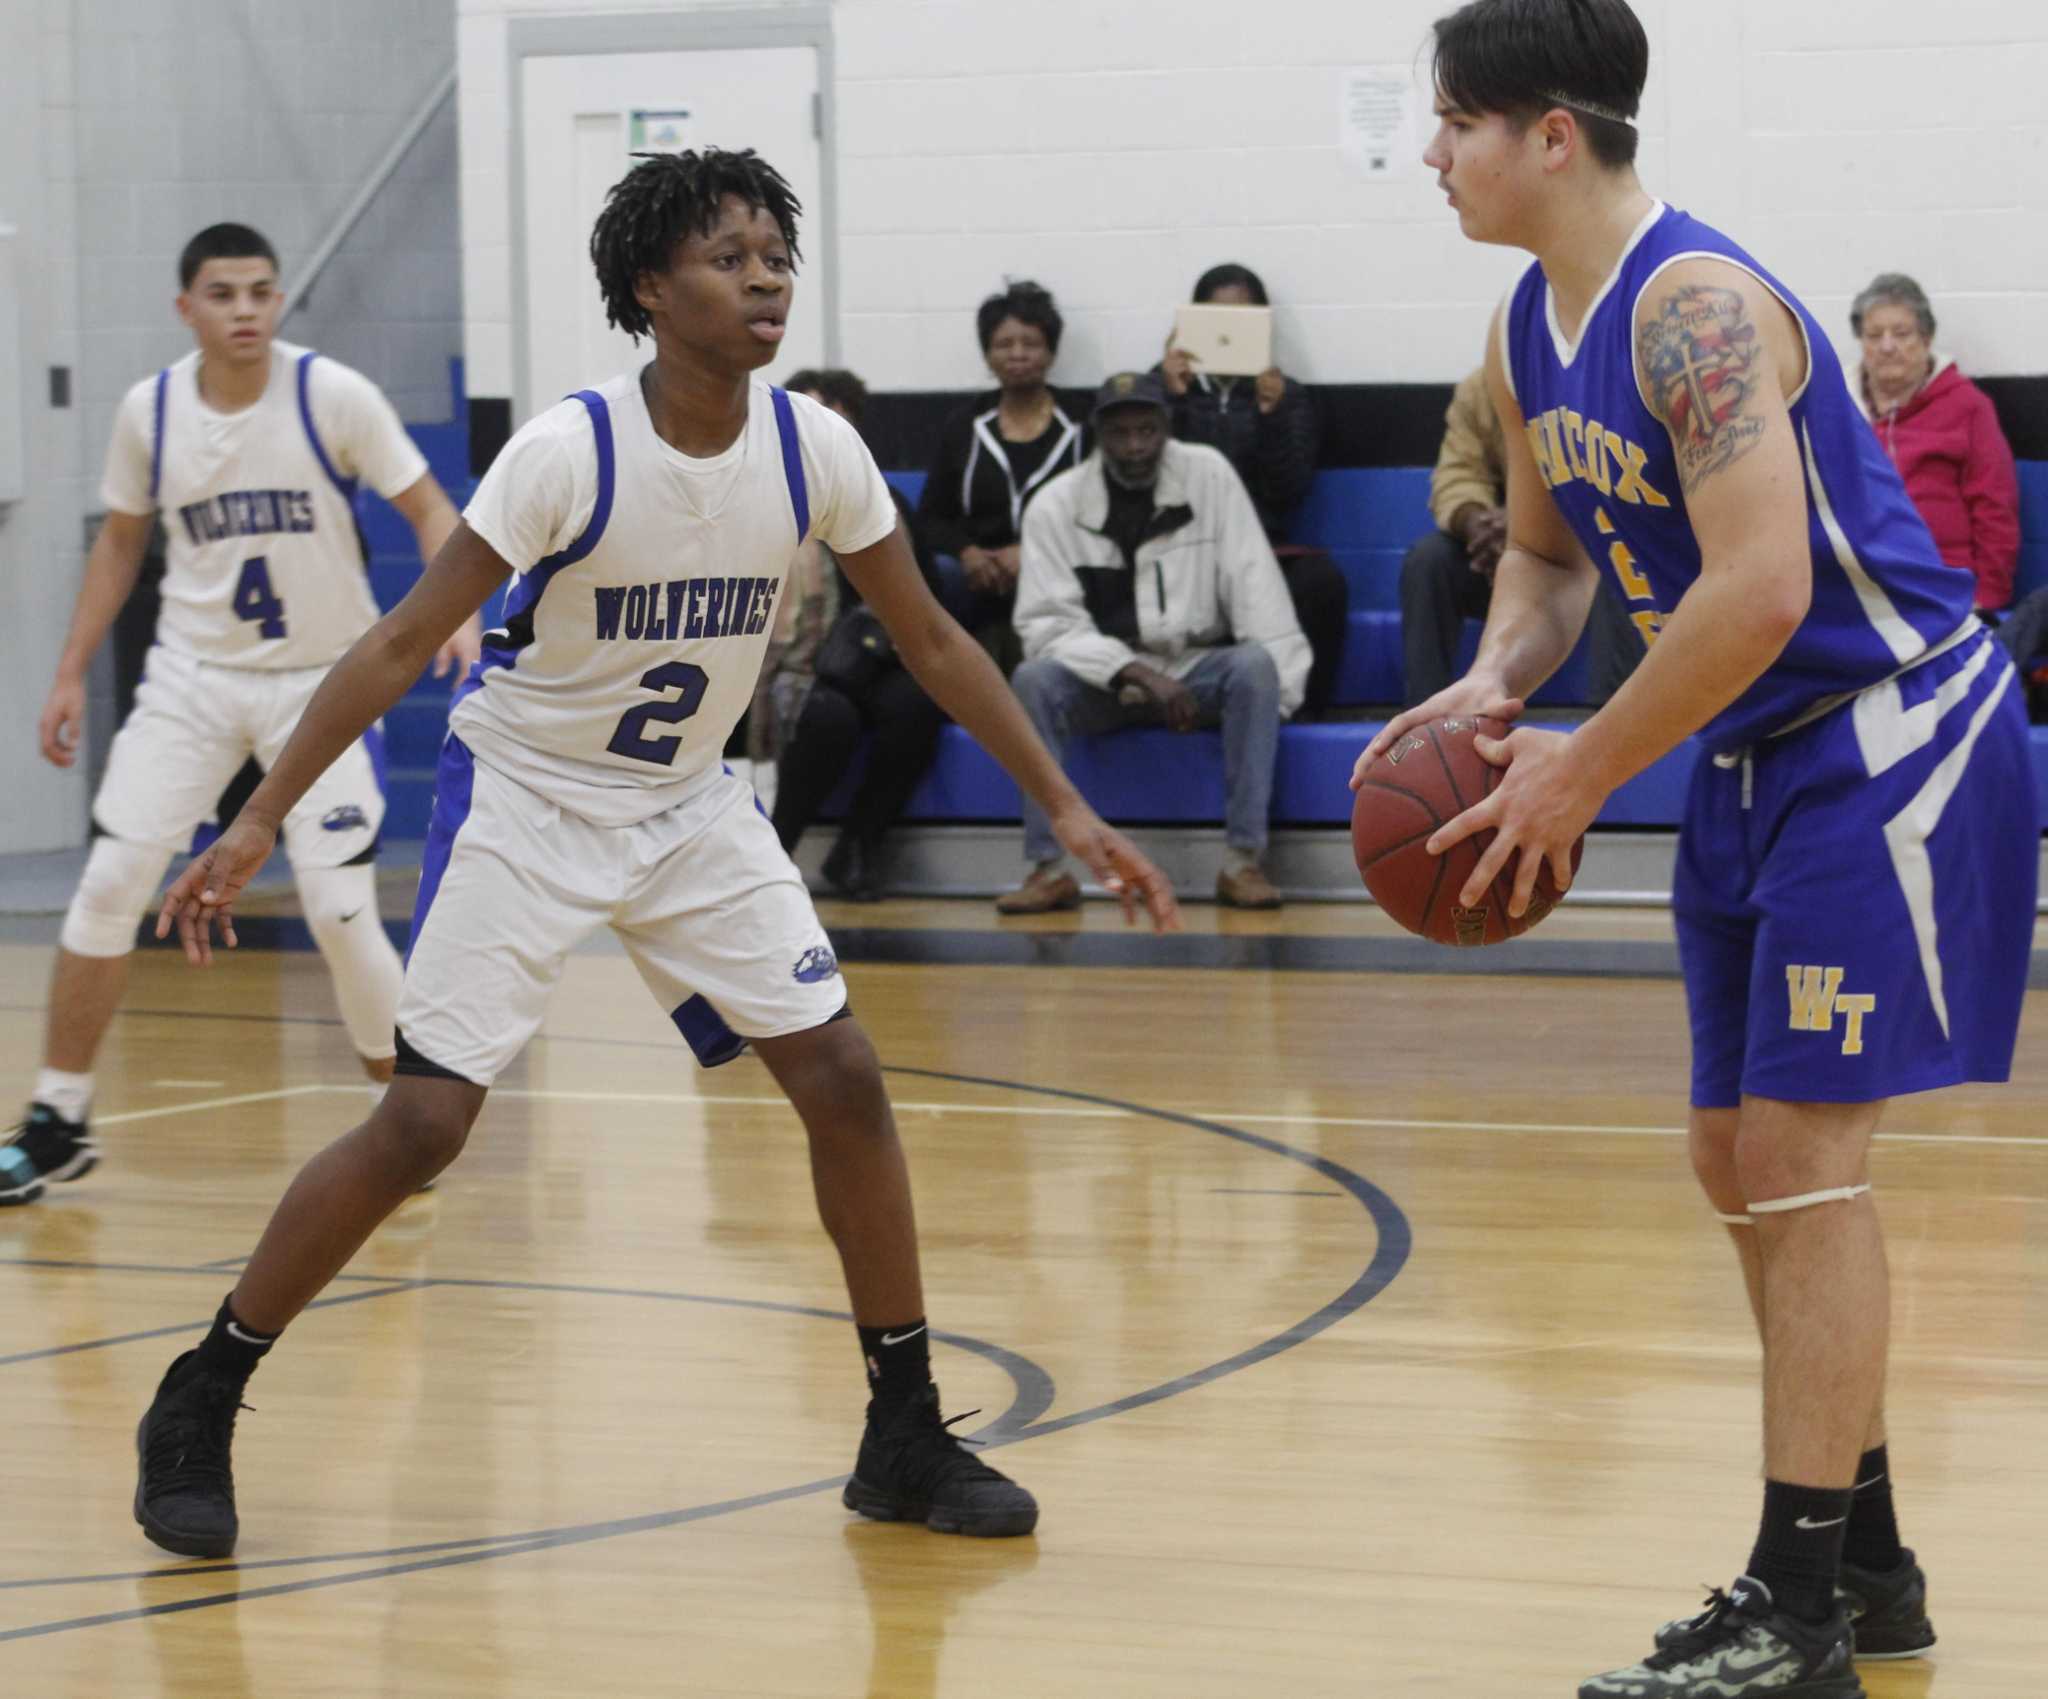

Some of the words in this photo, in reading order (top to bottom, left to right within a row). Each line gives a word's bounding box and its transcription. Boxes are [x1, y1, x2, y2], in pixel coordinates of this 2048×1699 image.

[232, 556, 287, 639] 4
[594, 577, 780, 641] WOLVERINES
[606, 661, 710, 766] 2
[1786, 964, 1876, 1055] WT
